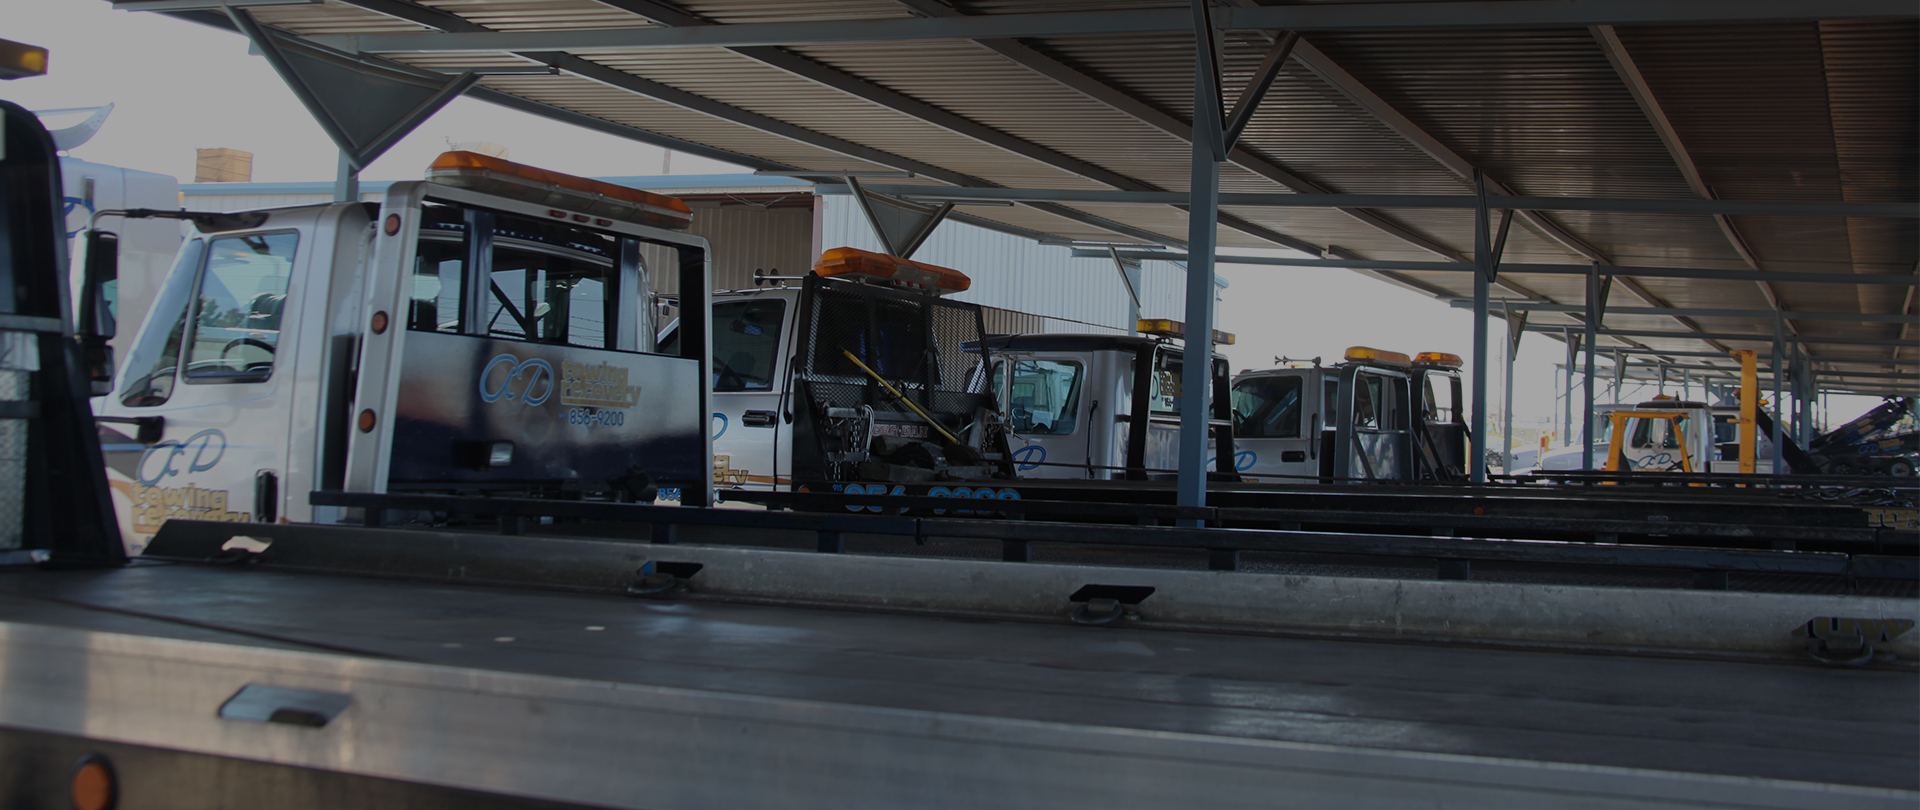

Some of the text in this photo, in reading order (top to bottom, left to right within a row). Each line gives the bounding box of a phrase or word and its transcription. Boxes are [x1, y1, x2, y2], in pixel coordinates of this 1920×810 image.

[562, 359, 628, 384] towing
[561, 379, 641, 405] recovery
[569, 408, 625, 427] 856-9200
[131, 482, 227, 512] towing
